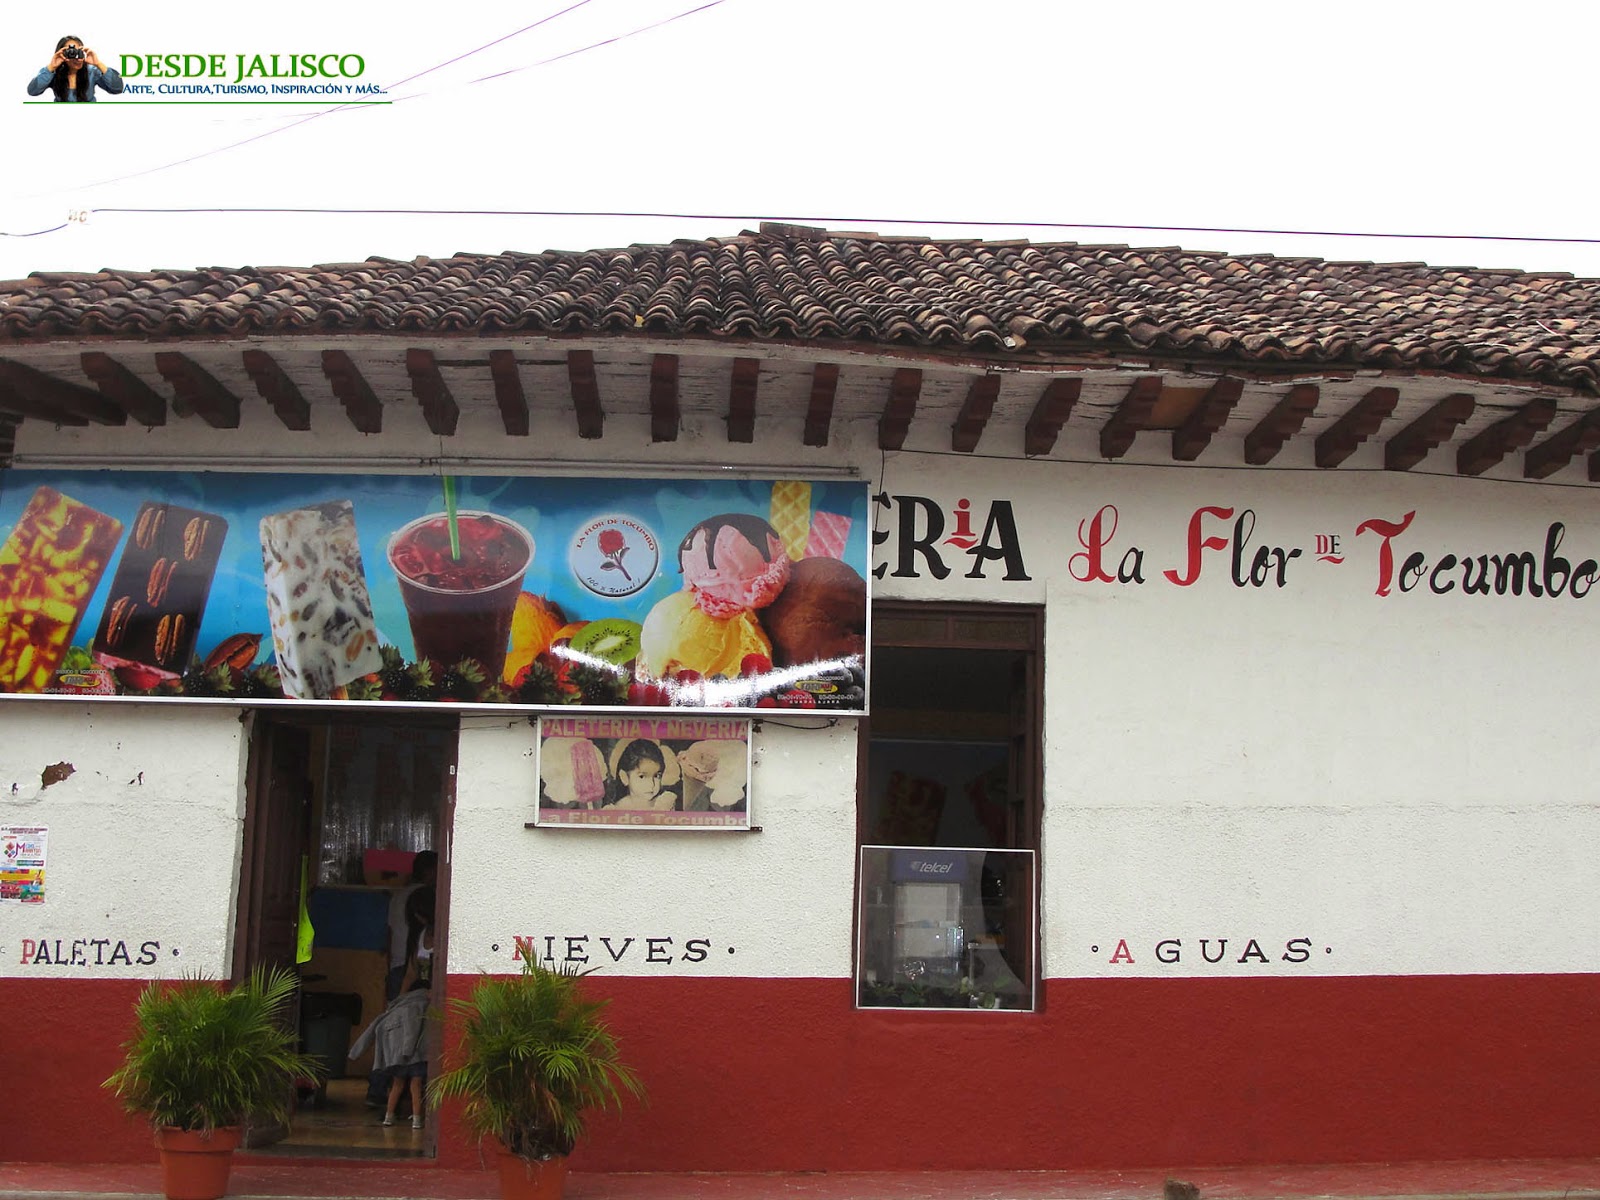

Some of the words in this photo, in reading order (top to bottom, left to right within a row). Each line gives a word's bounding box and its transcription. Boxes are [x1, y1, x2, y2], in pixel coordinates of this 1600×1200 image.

[577, 536, 586, 549] LA
[584, 521, 605, 536] FLOR
[1068, 504, 1146, 585] La
[1163, 505, 1303, 589] Flor
[1314, 534, 1344, 560] DE
[1355, 510, 1600, 599] Tocumbo
[541, 719, 642, 737] PALETERIA
[649, 720, 661, 737] Y
[665, 720, 747, 739] NEVERIA
[568, 812, 610, 824] Flor
[617, 813, 645, 825] de
[919, 861, 954, 874] telcel
[20, 938, 161, 966] PALETAS
[512, 935, 711, 965] NIEVES
[1109, 937, 1312, 964] AGUAS
